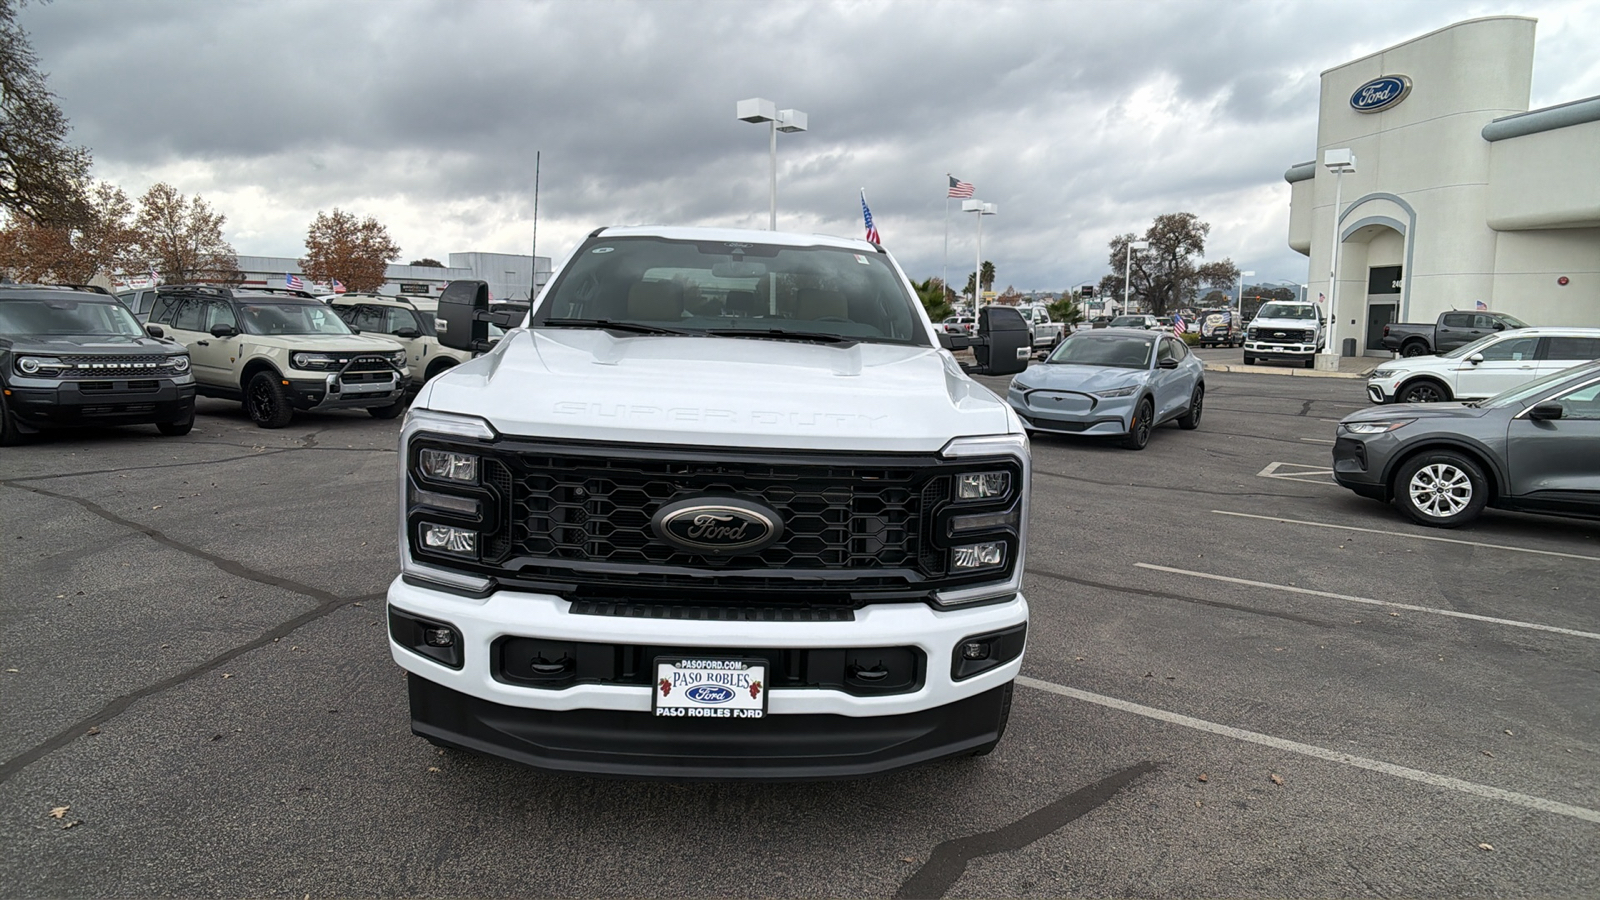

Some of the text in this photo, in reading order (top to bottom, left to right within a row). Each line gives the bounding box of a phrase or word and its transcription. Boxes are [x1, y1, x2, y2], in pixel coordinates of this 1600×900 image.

[1359, 82, 1392, 106] Ford
[552, 400, 888, 429] SUPER DUTY
[687, 514, 748, 539] Ford
[681, 660, 742, 670] PASOFORD.COM
[673, 672, 750, 689] PASO ROBLES
[695, 687, 726, 699] Ford
[656, 707, 686, 717] PASO
[688, 708, 731, 718] ROBLES
